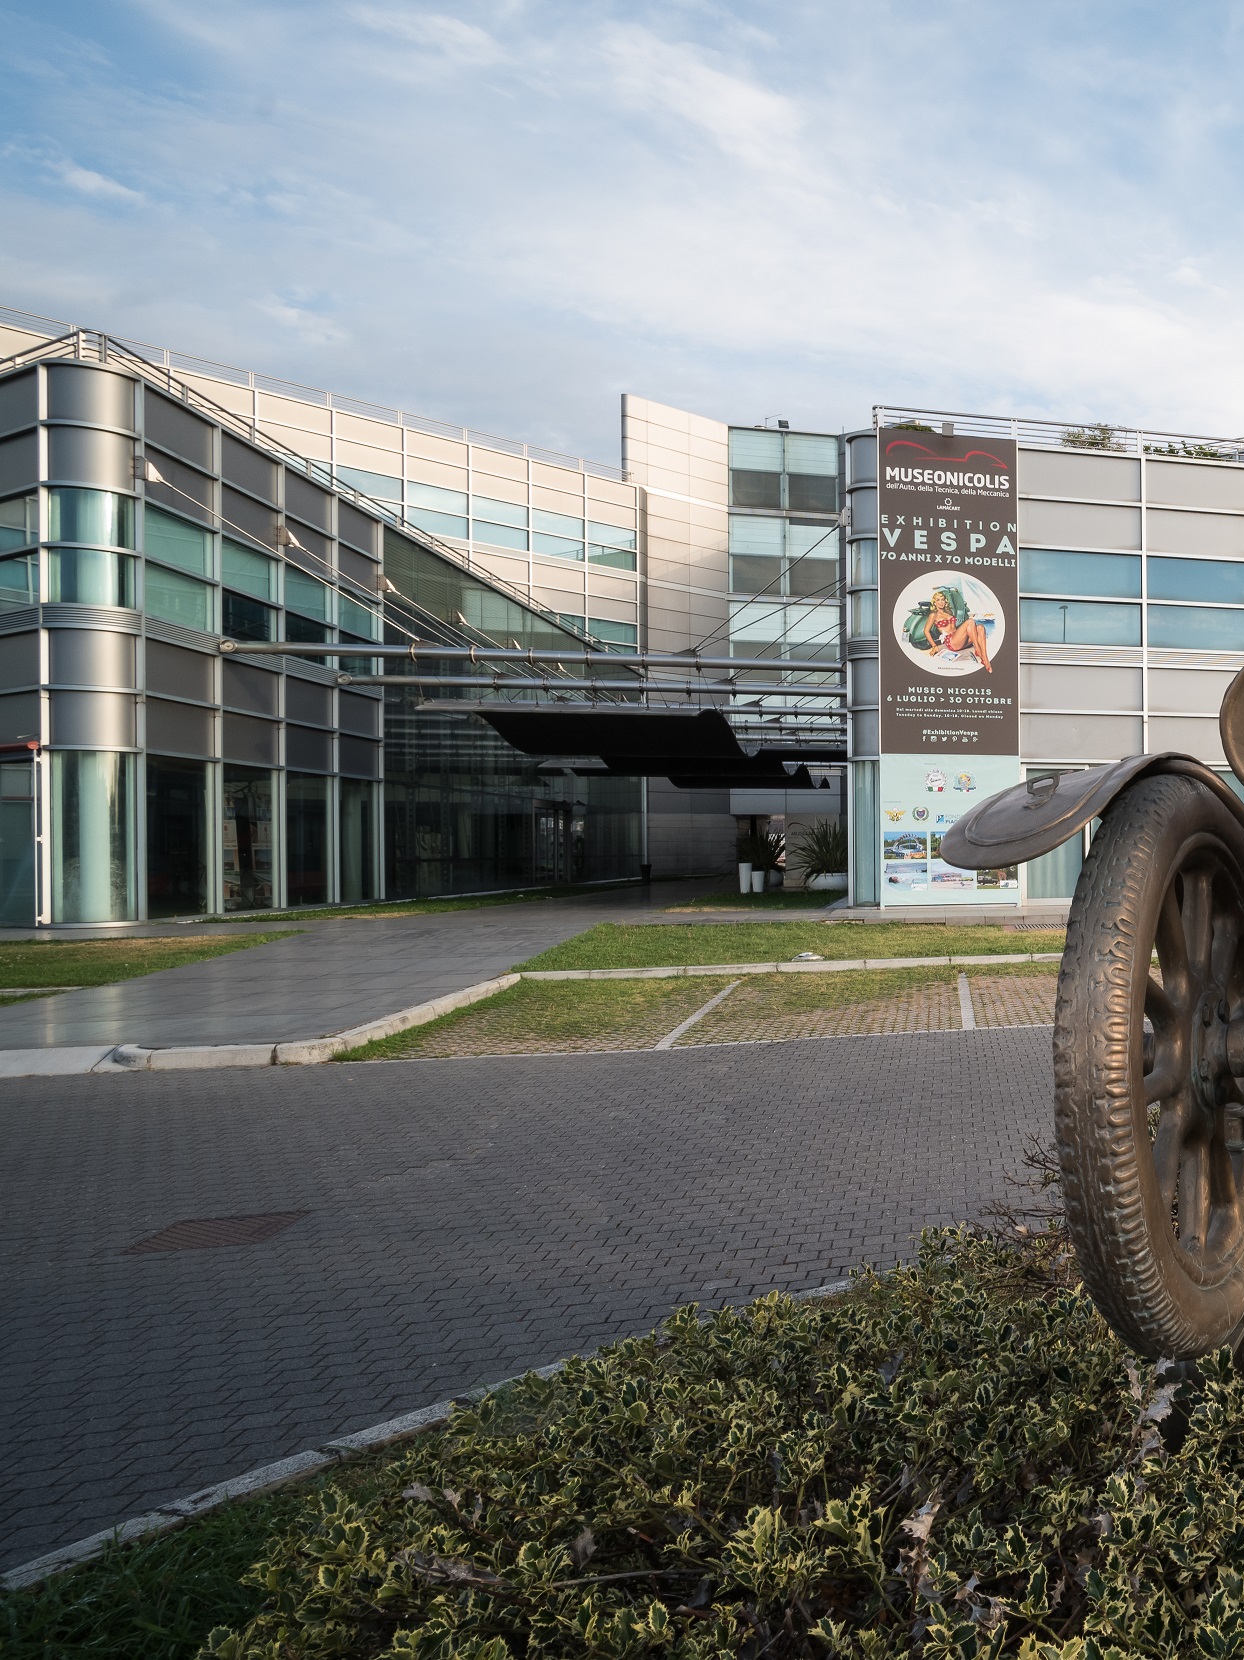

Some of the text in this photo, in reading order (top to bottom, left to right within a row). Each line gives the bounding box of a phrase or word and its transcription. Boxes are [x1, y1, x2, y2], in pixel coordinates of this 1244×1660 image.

[886, 466, 1010, 490] MUSEONICOLIS
[886, 482, 916, 491] dell'Auto,
[934, 486, 960, 494] Tecnica,
[961, 488, 976, 496] della
[977, 489, 1010, 498] Meccanica
[881, 514, 1017, 533] EXHIBITION
[882, 527, 1015, 555] VESPA
[881, 551, 1016, 568] 70 ANNI X 70 MODELLI
[908, 686, 992, 696] MUSEO NICOLIS
[886, 694, 893, 702] 6
[897, 695, 936, 703] LUGLIO
[949, 696, 962, 704] 30
[966, 696, 1012, 705] OTTOBRE
[922, 729, 978, 737] #ExhibitionVespa
